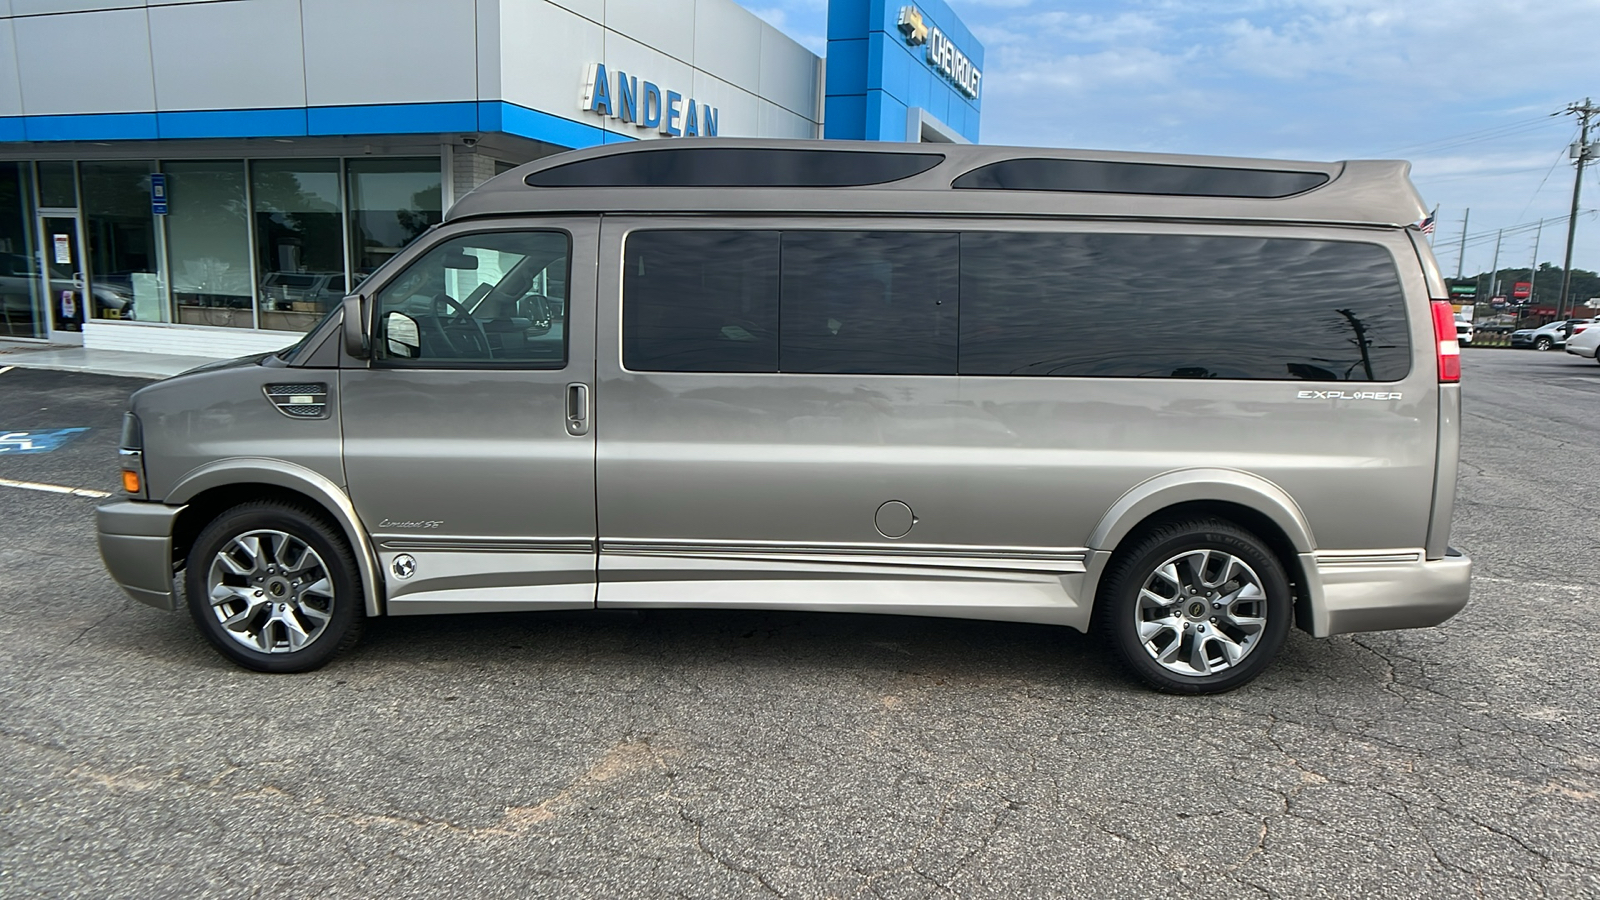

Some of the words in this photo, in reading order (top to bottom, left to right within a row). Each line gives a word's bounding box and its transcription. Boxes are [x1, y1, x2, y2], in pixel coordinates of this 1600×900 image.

[930, 27, 981, 99] CHEVROLET
[586, 63, 719, 137] ANDEAN
[1297, 390, 1403, 400] EXPLORER
[379, 518, 424, 528] Limited
